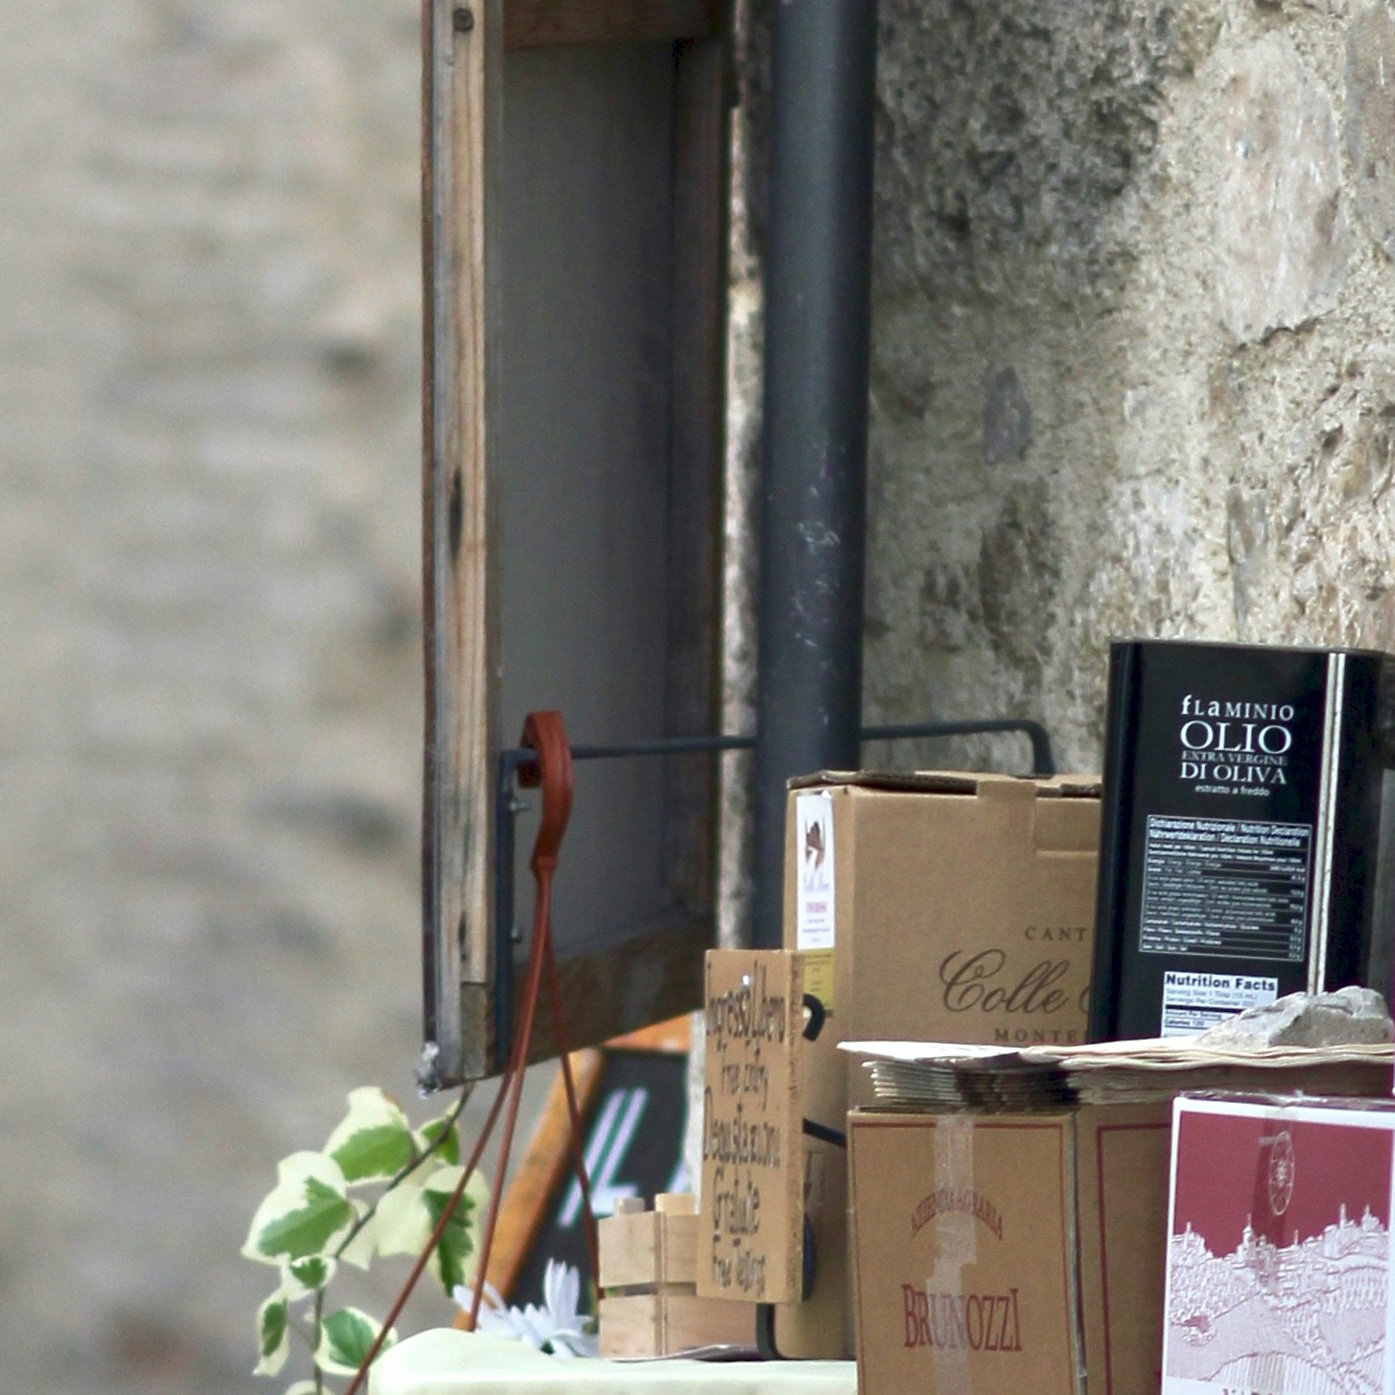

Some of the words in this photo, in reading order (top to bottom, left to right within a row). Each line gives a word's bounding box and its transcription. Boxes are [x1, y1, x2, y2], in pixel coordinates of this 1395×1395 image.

[1180, 720, 1291, 754] OLIO
[1182, 750, 1224, 762] EXTRA
[1228, 752, 1288, 766] VERGINE
[1180, 762, 1206, 779] DI
[1213, 764, 1286, 784] OLIVA
[939, 948, 1069, 1013] Colle
[1165, 974, 1230, 989] Nutrition
[1235, 978, 1276, 991] Facts
[902, 1284, 1022, 1352] BRUNOZZI
